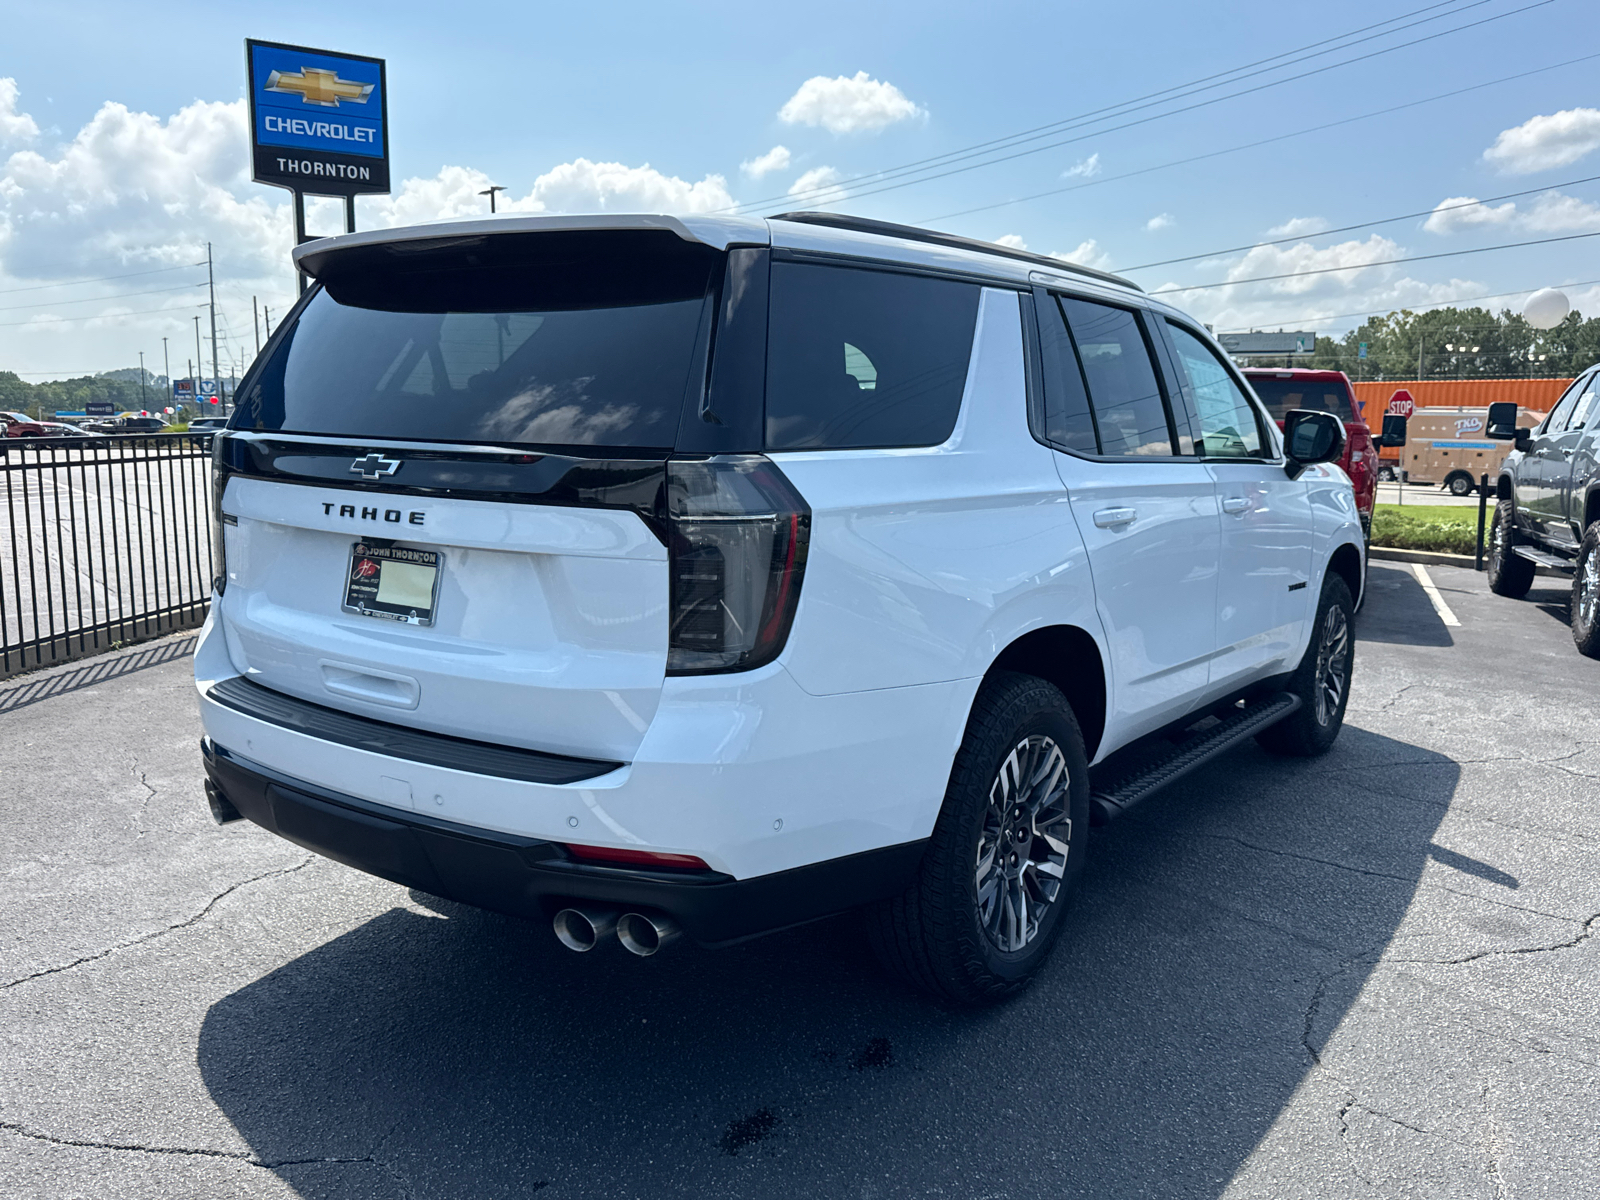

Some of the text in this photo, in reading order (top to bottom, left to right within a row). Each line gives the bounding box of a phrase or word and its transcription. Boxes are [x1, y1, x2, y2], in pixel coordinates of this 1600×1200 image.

[265, 116, 376, 143] CHEVROLET
[277, 158, 370, 180] THORNTON
[1390, 400, 1412, 414] STOP
[322, 502, 426, 525] TAHOE
[369, 547, 391, 557] JOHN
